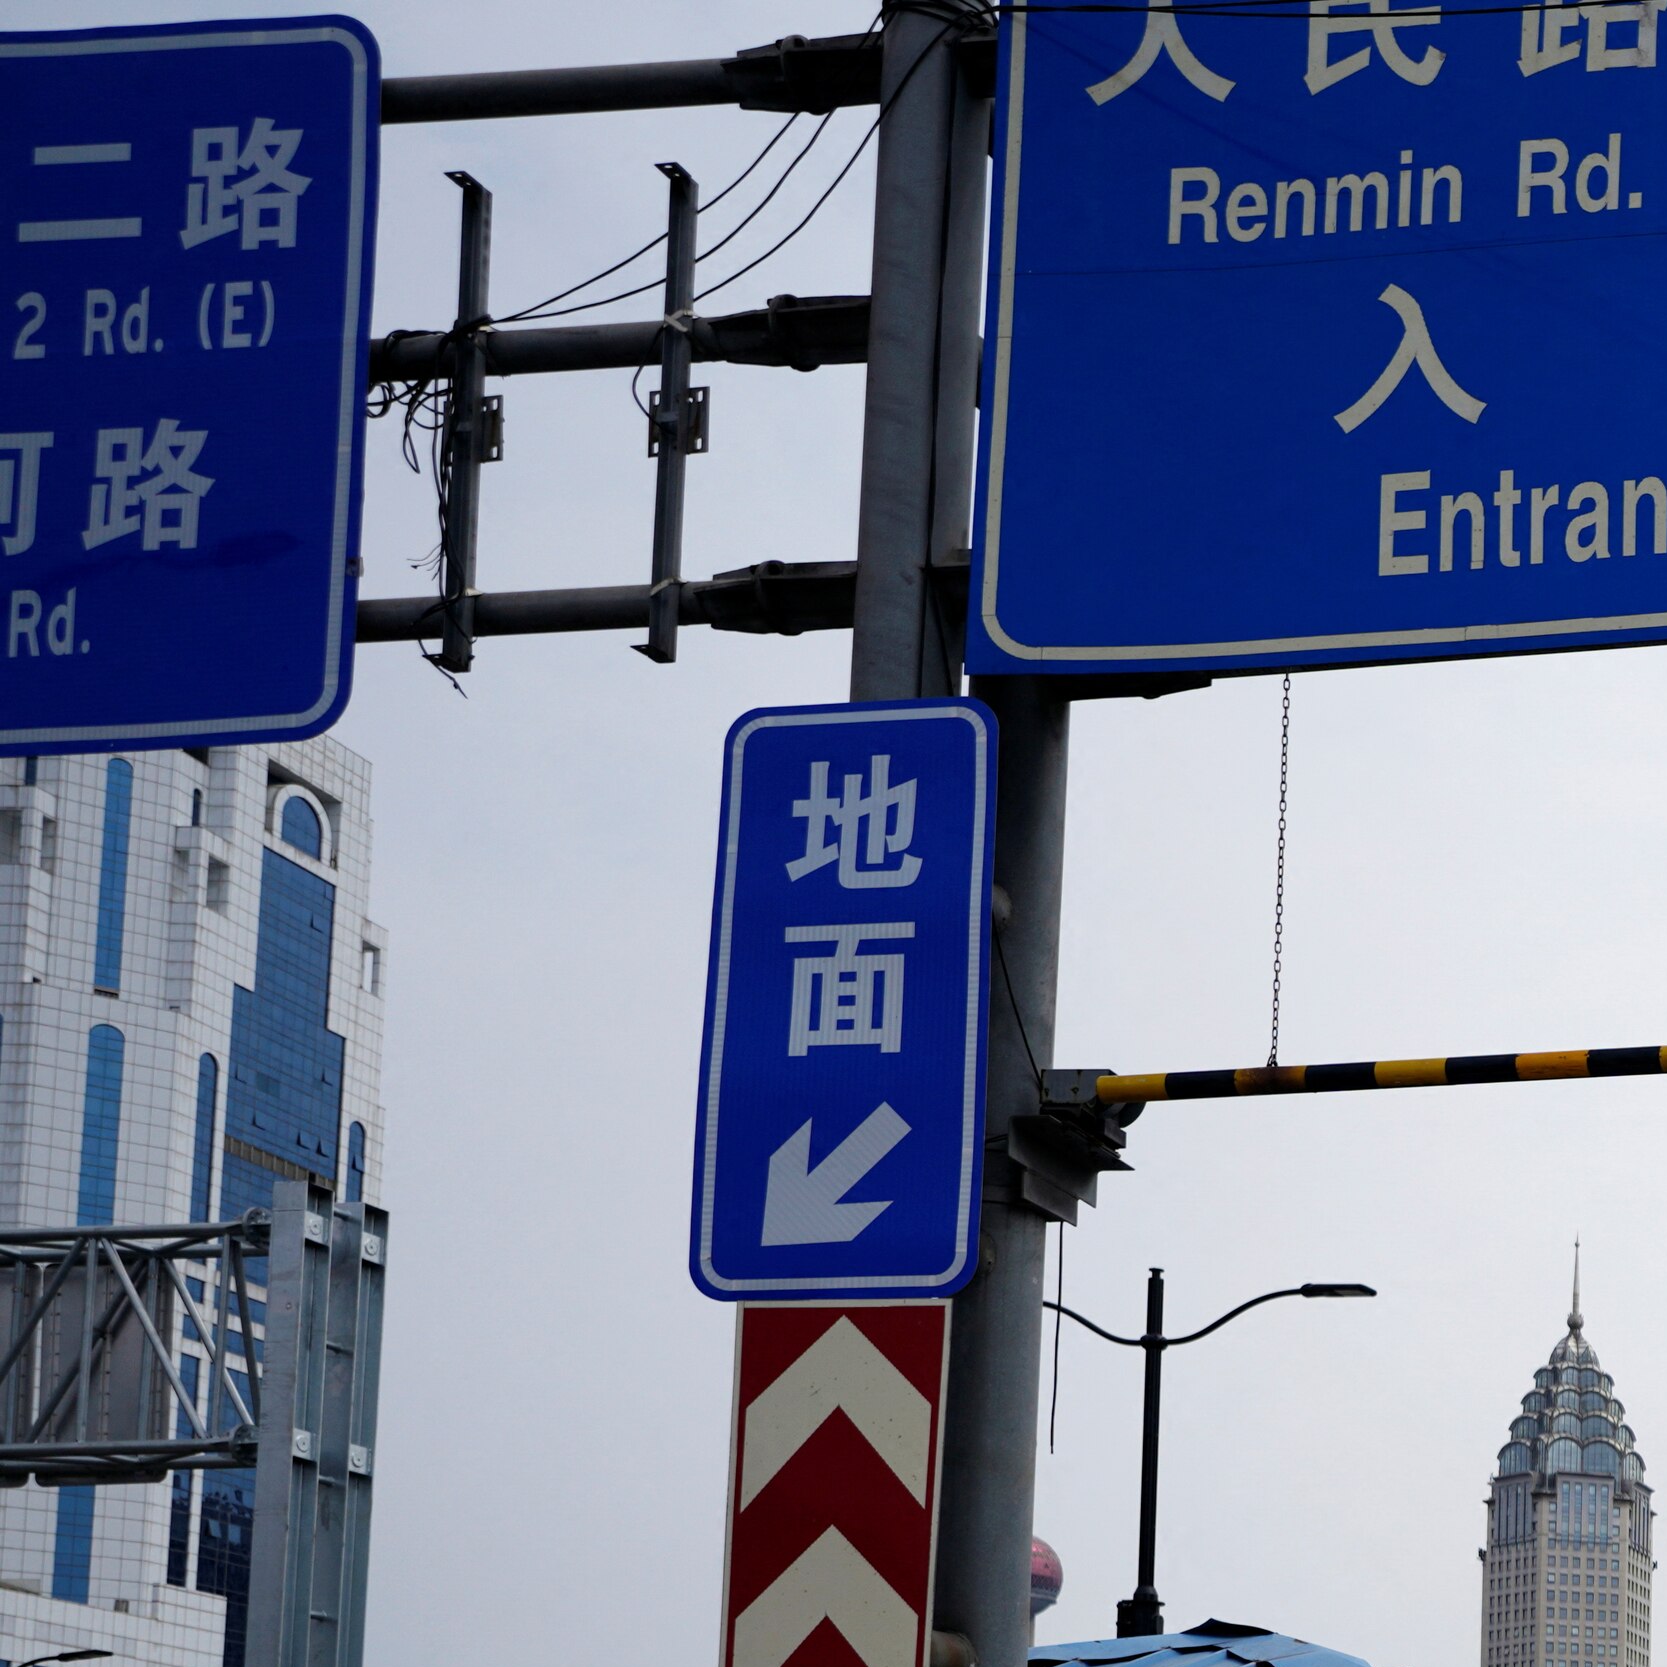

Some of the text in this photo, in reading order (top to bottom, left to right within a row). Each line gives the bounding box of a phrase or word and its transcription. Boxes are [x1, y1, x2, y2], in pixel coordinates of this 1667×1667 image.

[18, 117, 313, 250] 二路
[1168, 149, 1462, 244] Renmin
[1517, 133, 1643, 217] Rd.
[13, 280, 275, 360] 2 Rd. (E)
[8, 586, 91, 658] Rd.
[785, 754, 923, 1057] 地面
